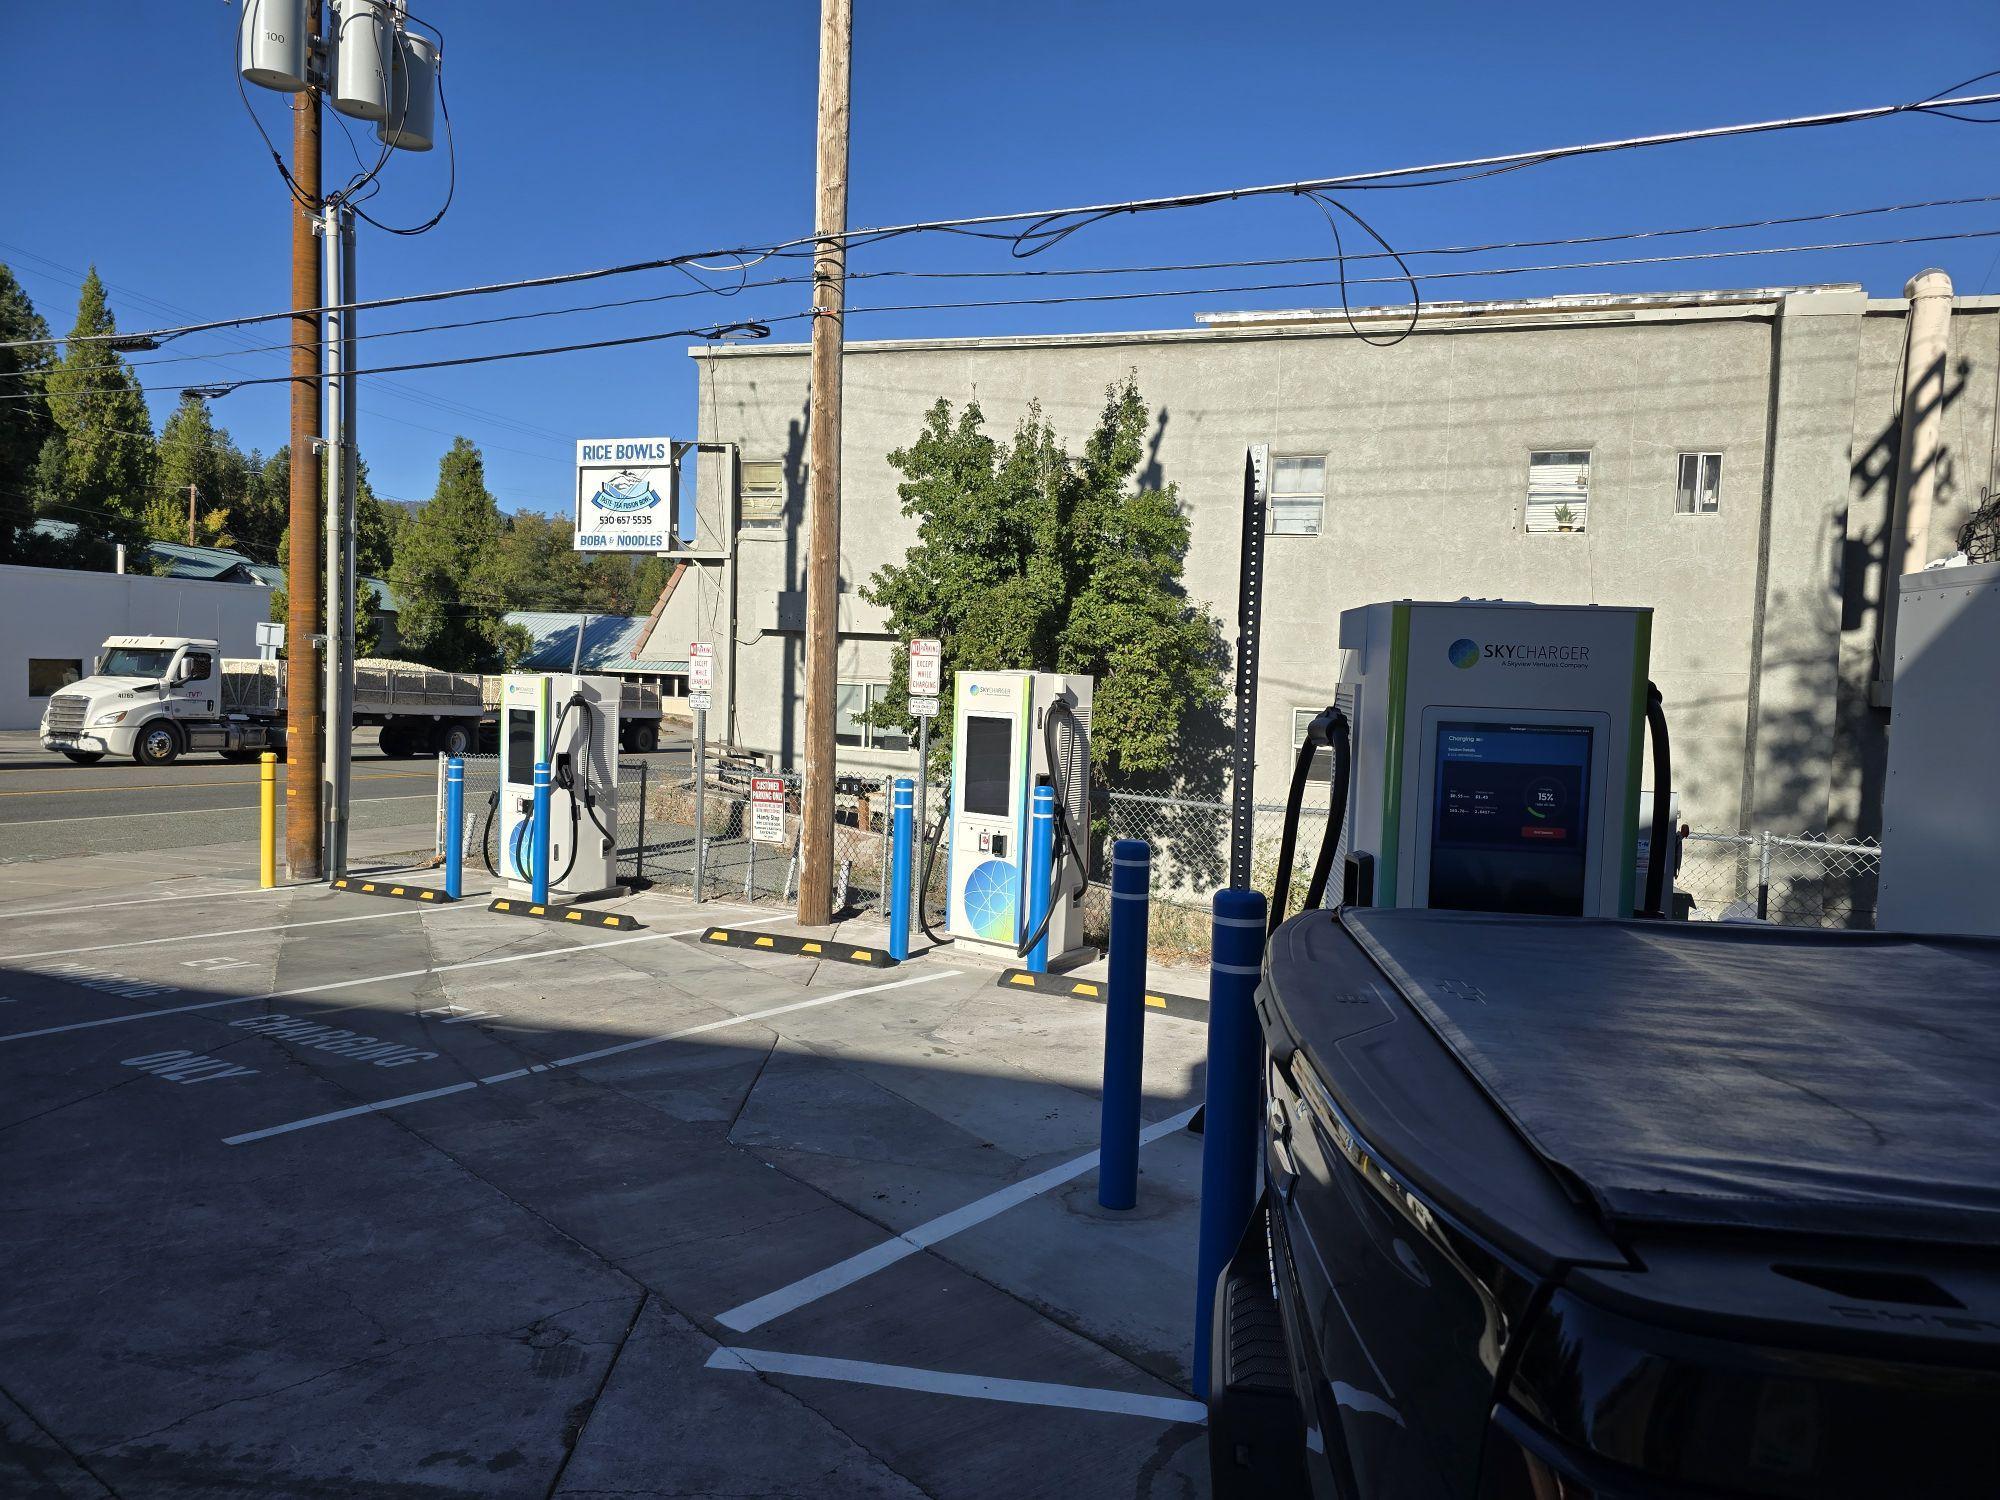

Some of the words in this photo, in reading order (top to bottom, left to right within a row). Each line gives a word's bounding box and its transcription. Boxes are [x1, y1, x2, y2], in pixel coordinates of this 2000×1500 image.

[265, 31, 285, 44] 100
[583, 445, 612, 460] RICE
[616, 444, 665, 459] BOWLS
[580, 535, 606, 546] BOBA
[617, 535, 663, 546] NOODLES
[1484, 644, 1590, 660] SKYCHARGER
[1538, 792, 1554, 801] 15%
[180, 956, 262, 971] EV
[228, 1014, 440, 1068] CHARGING
[120, 1049, 262, 1085] ONLY
